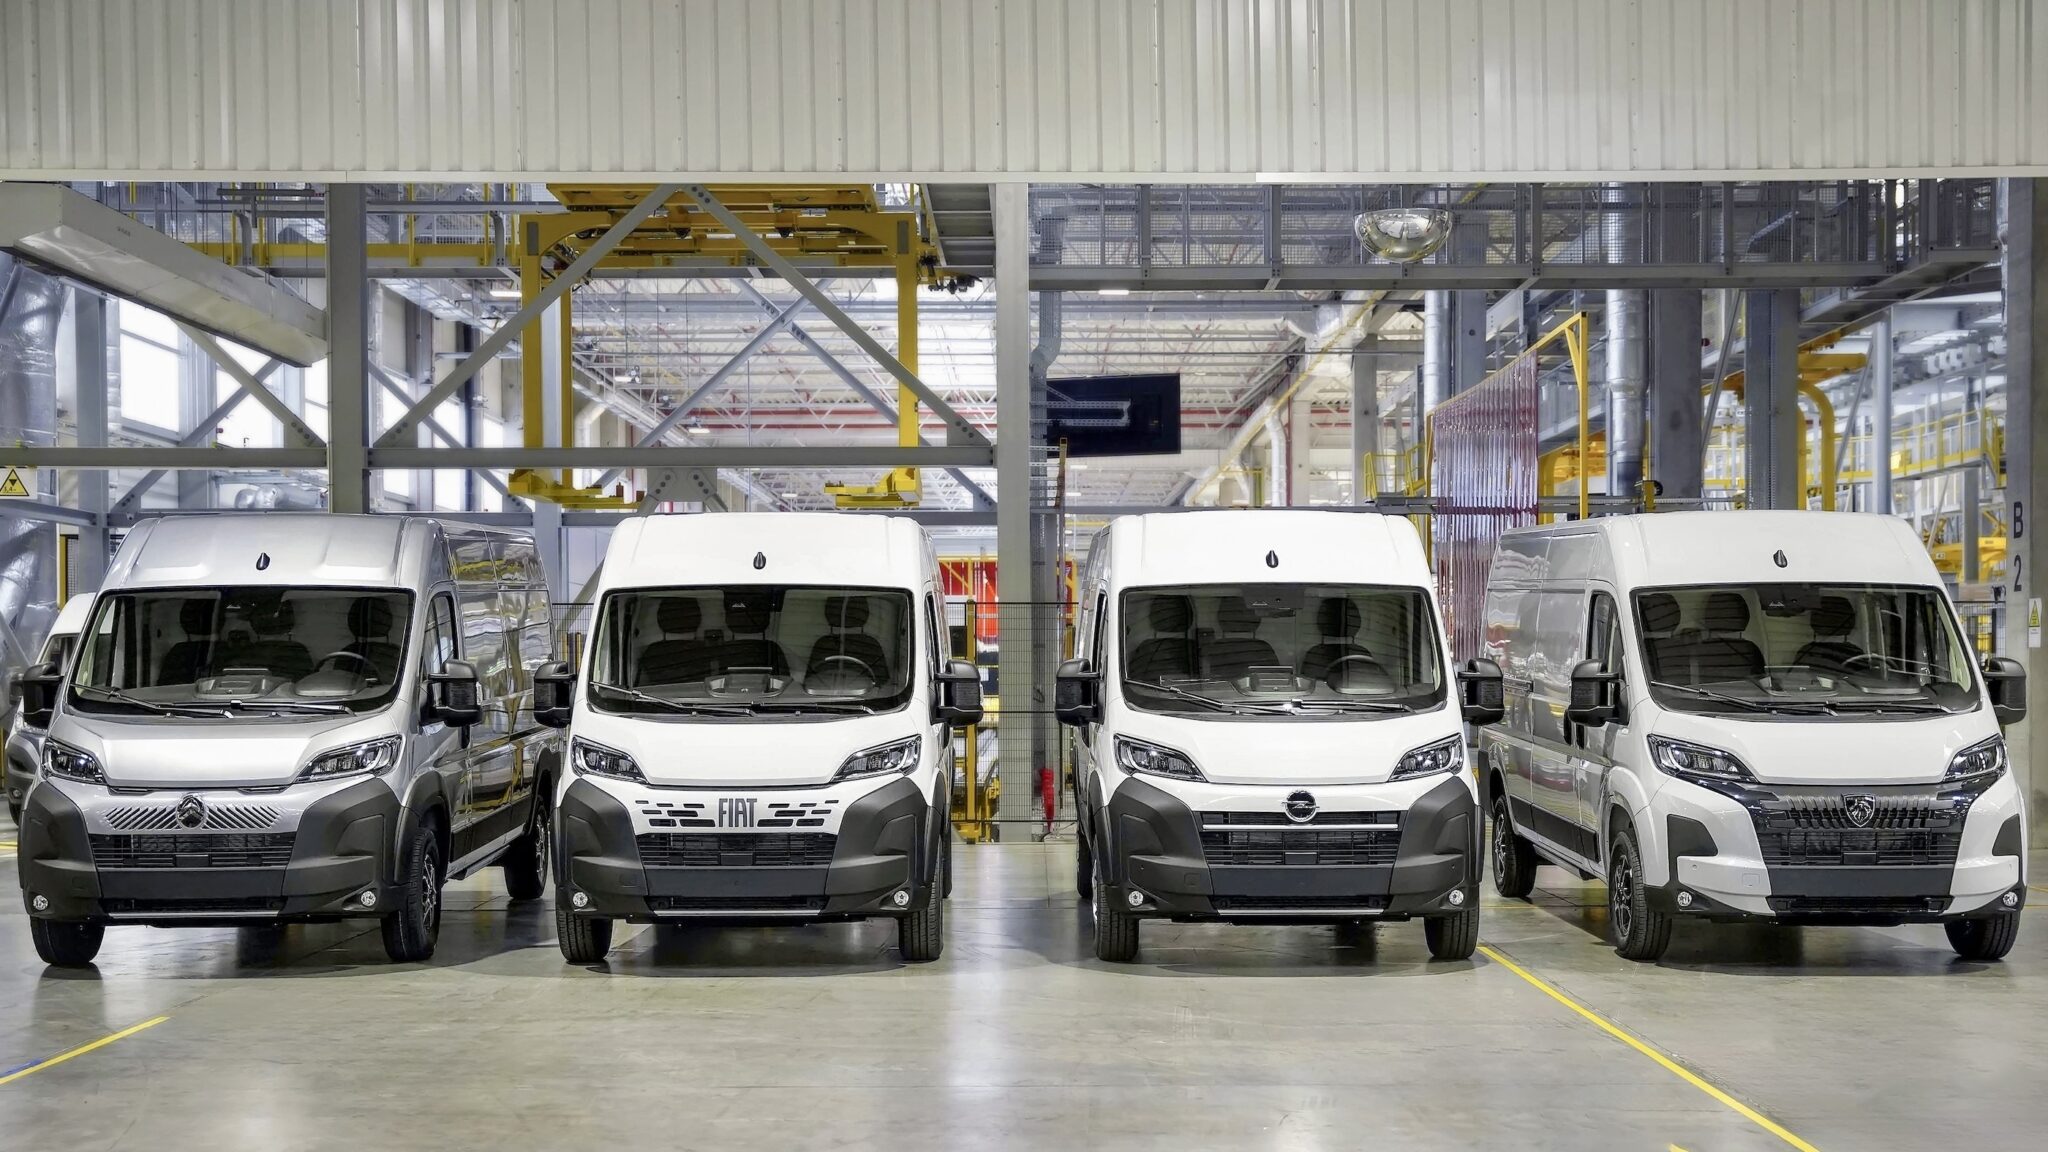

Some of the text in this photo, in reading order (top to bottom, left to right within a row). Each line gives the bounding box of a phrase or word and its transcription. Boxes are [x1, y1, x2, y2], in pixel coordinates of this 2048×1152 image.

[2013, 501, 2024, 539] B
[2013, 554, 2022, 592] 2
[718, 798, 758, 828] FIAT
